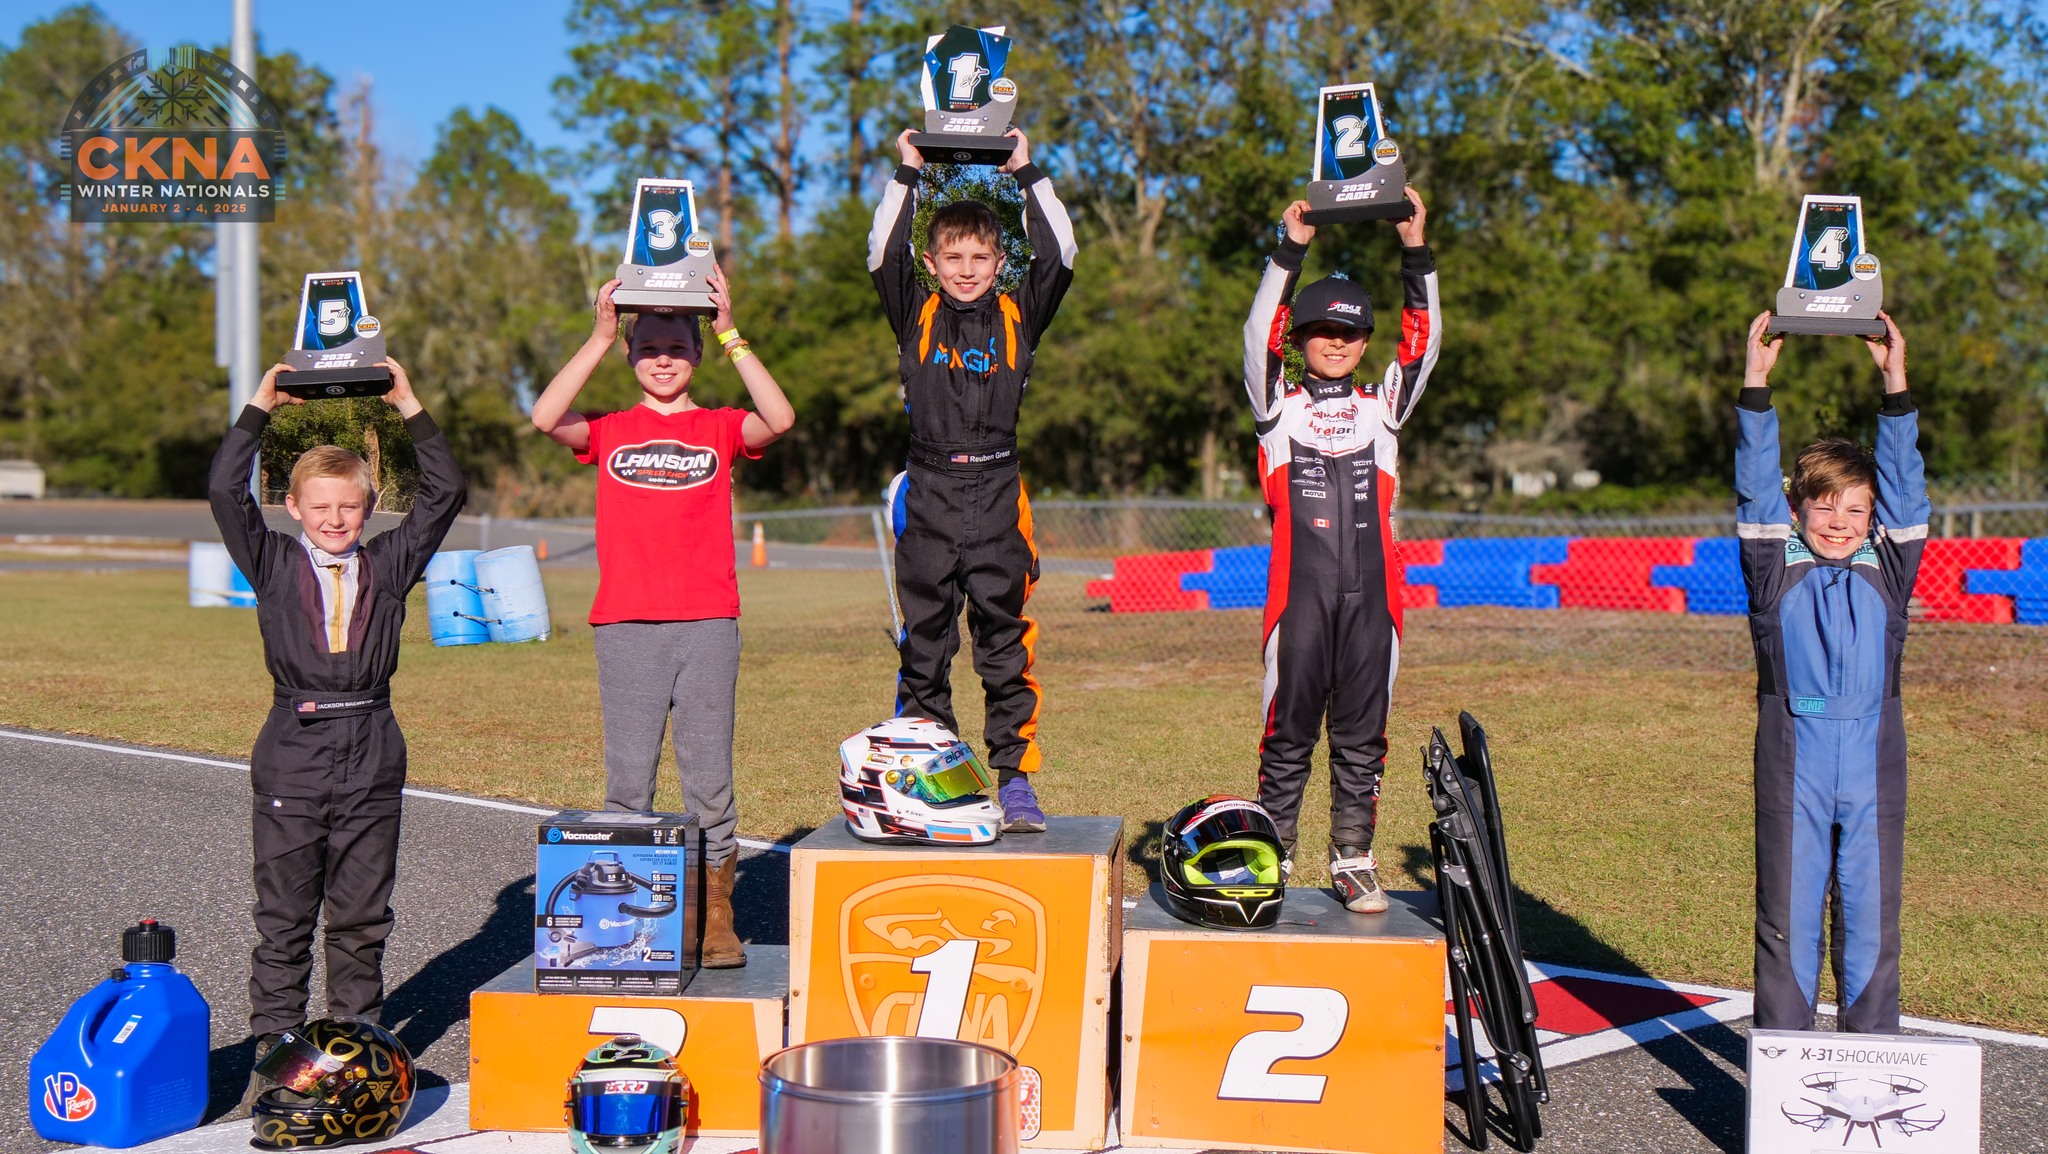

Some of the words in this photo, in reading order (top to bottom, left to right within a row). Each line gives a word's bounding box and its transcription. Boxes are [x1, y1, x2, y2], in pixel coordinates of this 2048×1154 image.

[948, 117, 980, 125] 2025
[942, 124, 985, 133] CADET
[1342, 183, 1373, 192] 2025
[1335, 190, 1379, 202] CADET
[651, 272, 683, 280] 2025
[644, 279, 688, 288] CADET
[1813, 295, 1847, 303] 2025
[1805, 303, 1852, 313] CADET
[320, 353, 352, 361] 2025
[313, 359, 358, 369] CADET
[614, 453, 713, 471] LAWSON
[969, 453, 995, 463] Reuben
[666, 471, 689, 479] SHOP
[1354, 492, 1368, 500] RK
[1788, 543, 1810, 551] OM
[1854, 544, 1873, 553] MP
[316, 701, 345, 710] JACKSON
[1797, 701, 1825, 711] OMP
[562, 830, 612, 841] Vacmaster
[651, 894, 663, 902] 100
[546, 916, 553, 927] 6
[642, 946, 652, 963] 2
[910, 938, 980, 1040] 1
[1217, 984, 1350, 1105] 2
[1799, 1047, 1834, 1062] X-31
[1835, 1048, 1929, 1066] SHOCKWAVE
[44, 1072, 80, 1120] VP
[68, 1096, 94, 1113] Racing
